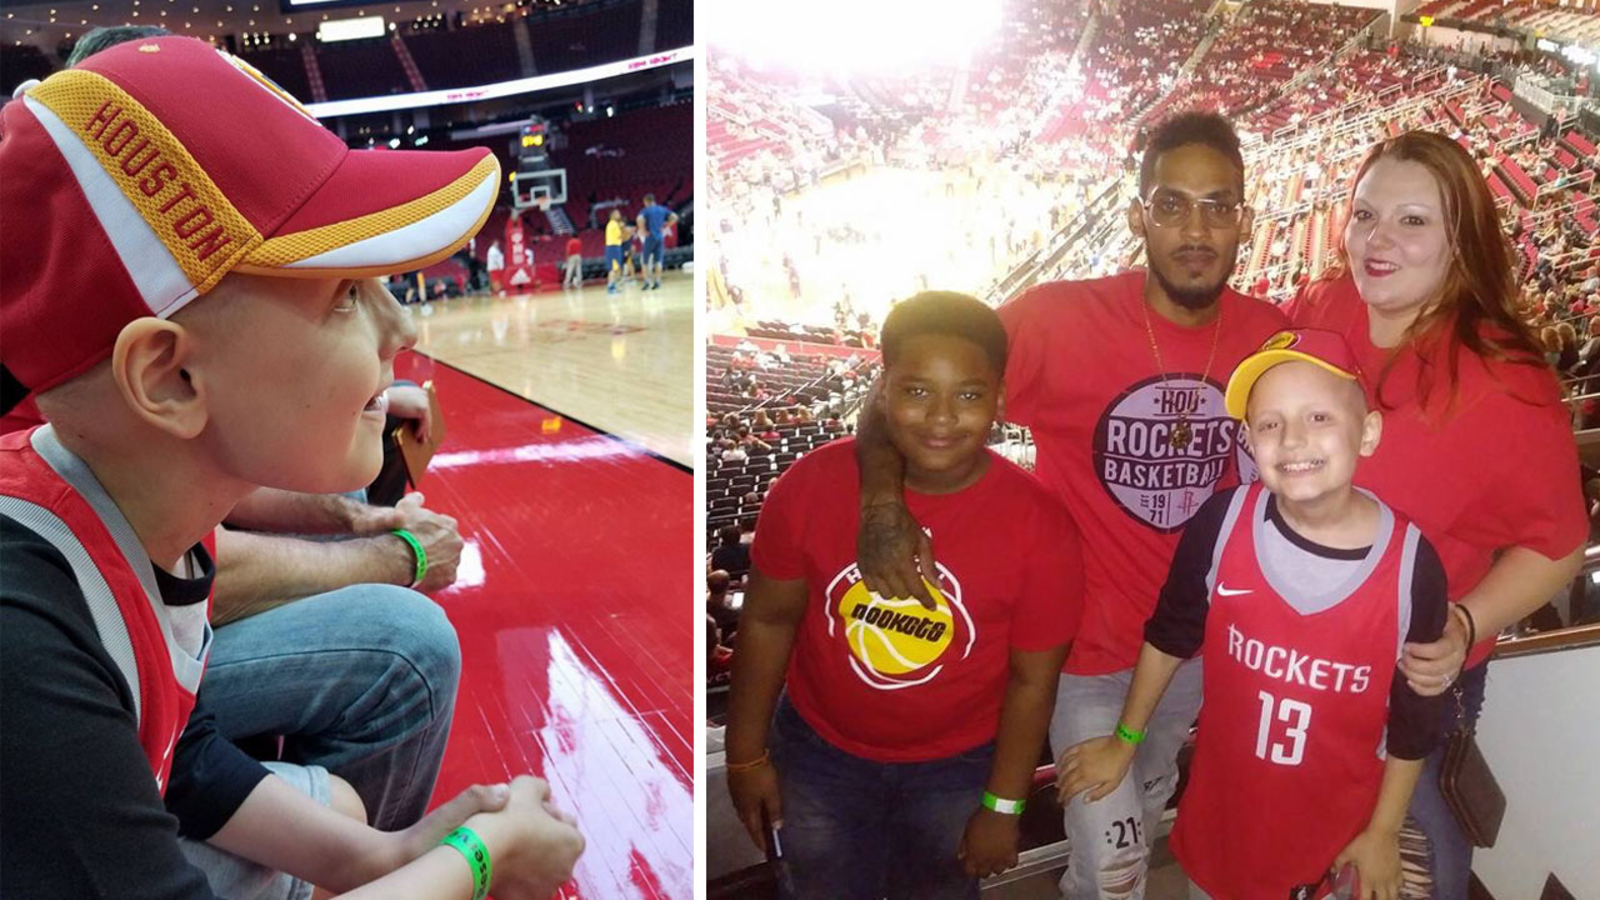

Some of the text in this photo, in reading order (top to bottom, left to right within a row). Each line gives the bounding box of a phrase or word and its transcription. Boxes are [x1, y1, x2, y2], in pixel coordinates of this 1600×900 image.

[86, 99, 234, 262] HOUSTON
[1161, 390, 1199, 414] HOU
[1104, 459, 1224, 488] BASKETBALL
[1152, 494, 1166, 509] 19
[1150, 509, 1163, 524] 71
[1228, 623, 1371, 693] ROCKETS
[1256, 690, 1312, 766] 13
